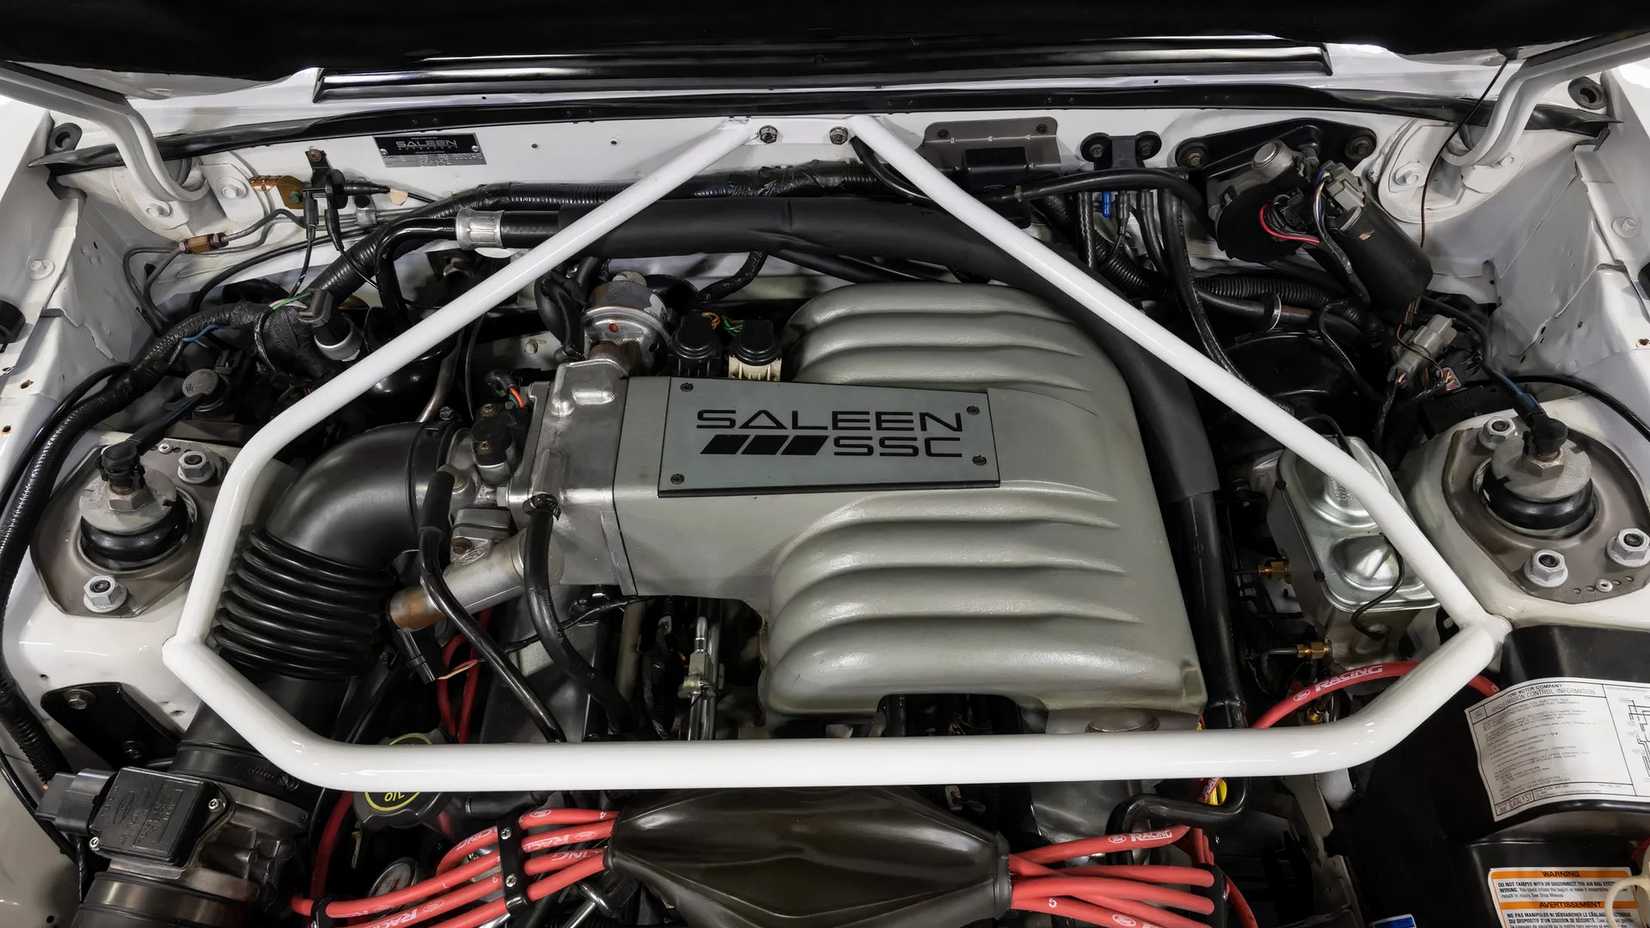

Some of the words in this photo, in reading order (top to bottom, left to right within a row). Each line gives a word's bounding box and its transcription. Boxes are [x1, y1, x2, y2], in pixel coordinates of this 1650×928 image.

[396, 139, 457, 148] SALEEN
[696, 409, 963, 432] SALEEN
[833, 436, 963, 457] SSC
[1315, 665, 1383, 692] RACING
[384, 792, 405, 802] OIL
[1539, 901, 1601, 909] AVERTISSEMENT
